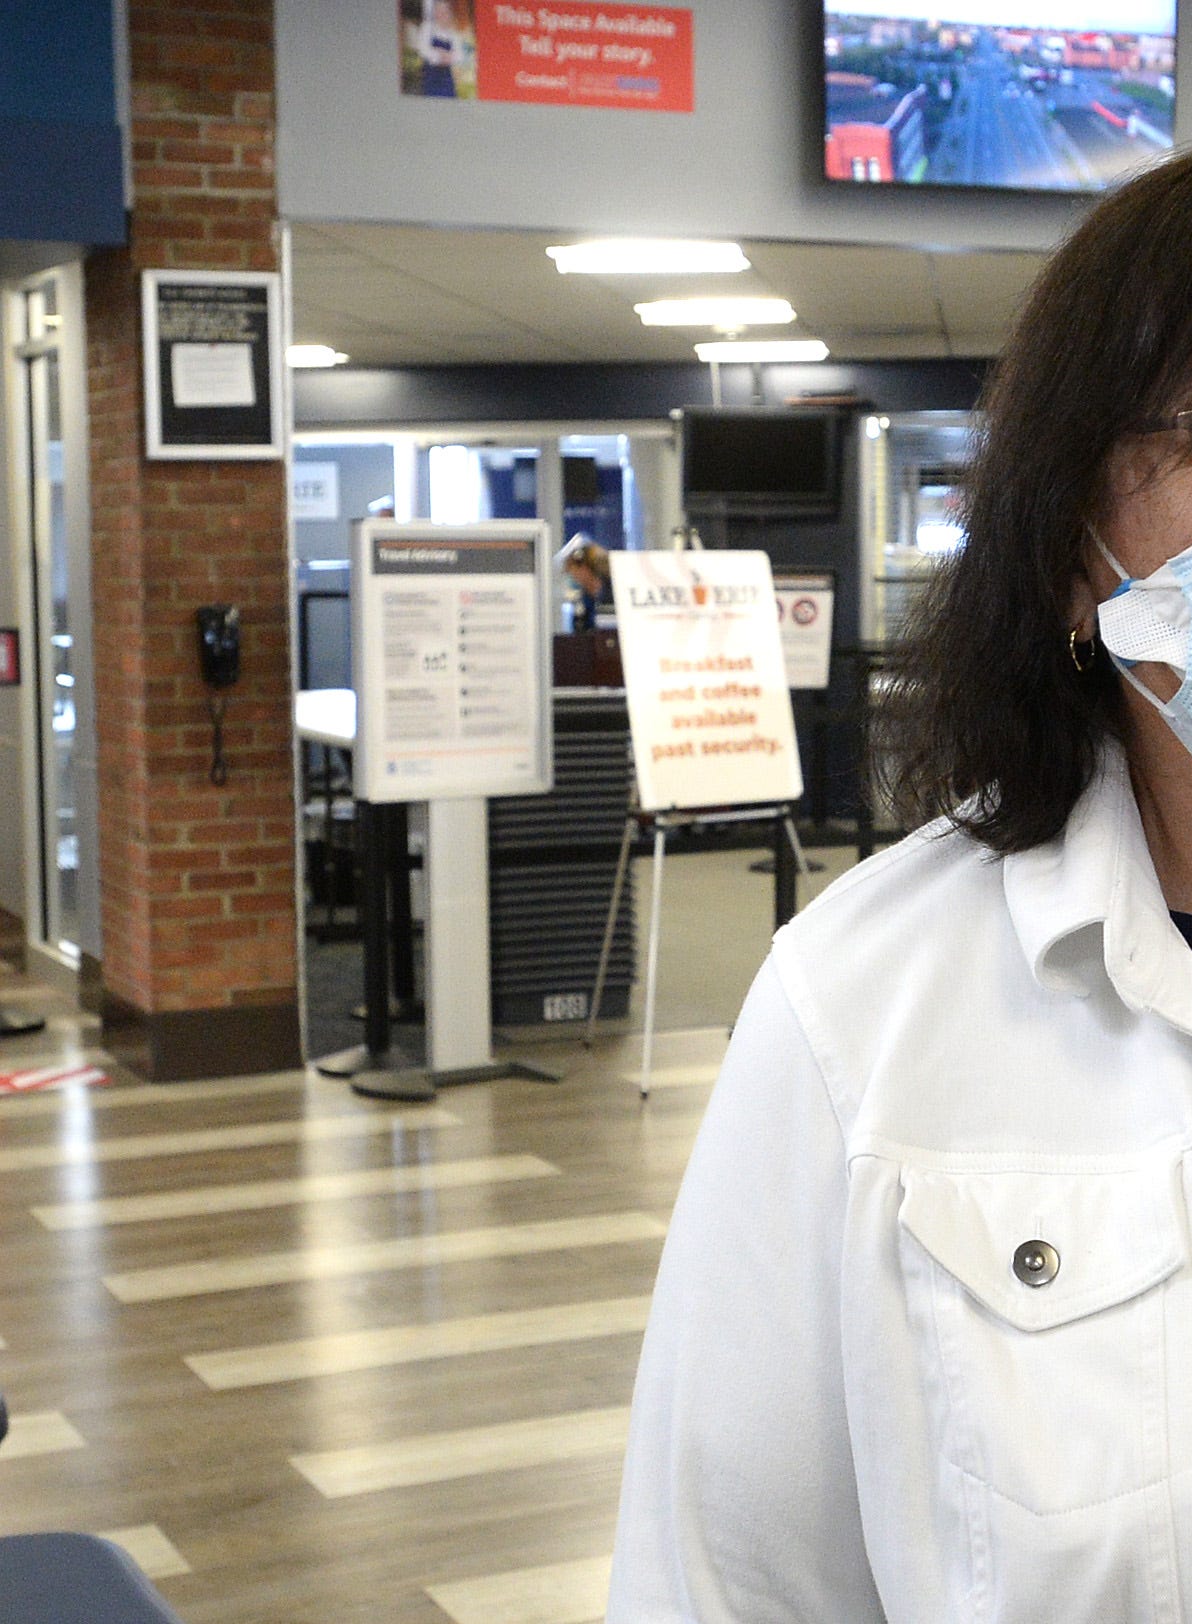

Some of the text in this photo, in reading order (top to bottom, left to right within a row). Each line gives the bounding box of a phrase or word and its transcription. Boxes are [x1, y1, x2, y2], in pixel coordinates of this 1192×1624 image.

[496, 5, 677, 38] This Space Available
[518, 34, 553, 56] Tell
[555, 43, 600, 64] your
[629, 585, 687, 607] LAKE
[658, 654, 753, 673] Breakfast
[658, 680, 762, 702] and coffee
[671, 710, 757, 730] available
[651, 742, 695, 764] past
